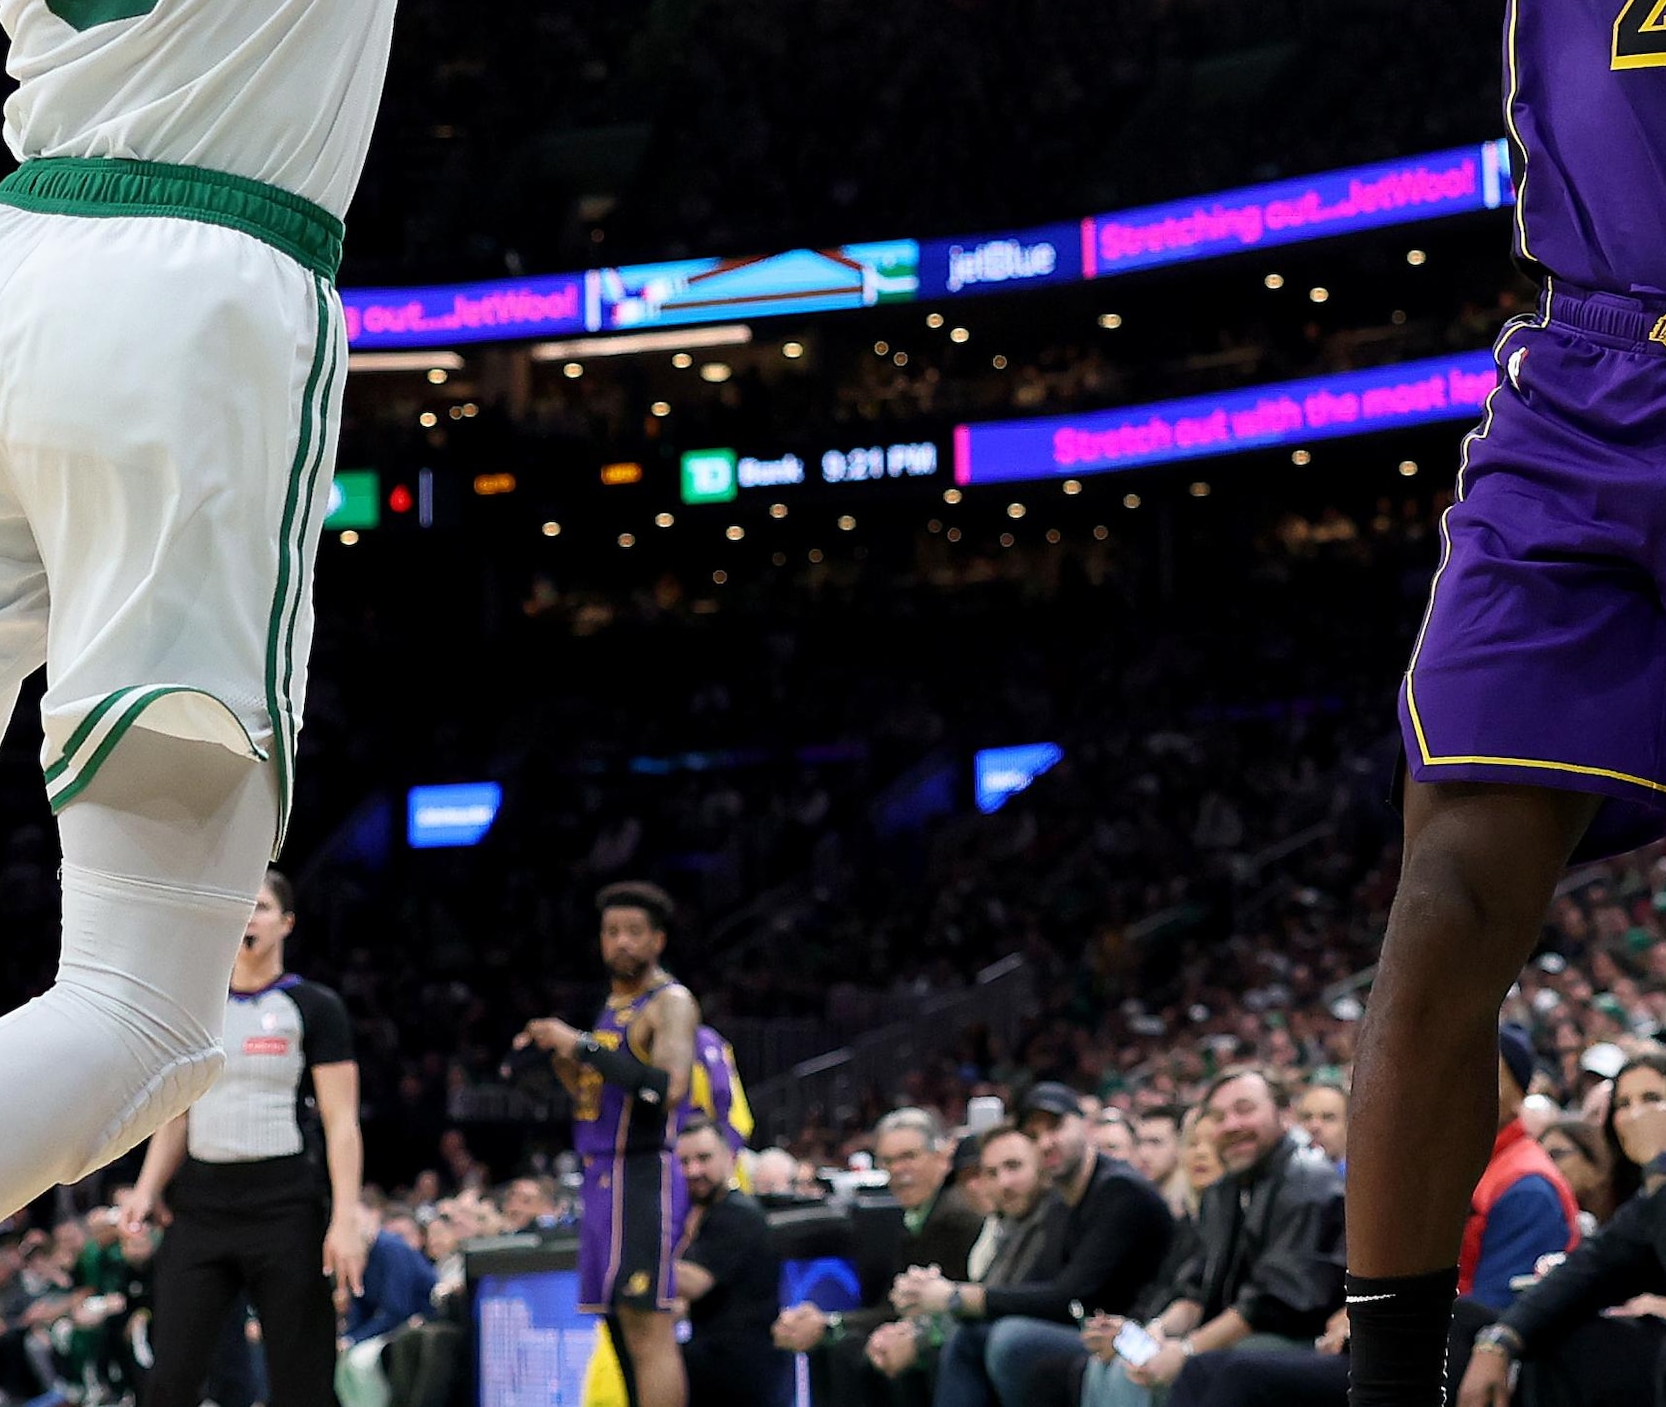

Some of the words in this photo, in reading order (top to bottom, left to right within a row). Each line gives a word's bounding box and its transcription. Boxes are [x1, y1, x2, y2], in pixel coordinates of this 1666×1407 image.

[1100, 205, 1263, 261] Stretching
[947, 242, 1056, 291] jetBlue
[1053, 418, 1171, 467] Stretch
[1174, 408, 1229, 451] out
[1231, 397, 1303, 443] with
[1306, 388, 1360, 429] the
[1362, 376, 1448, 419] most
[887, 441, 937, 478] PM
